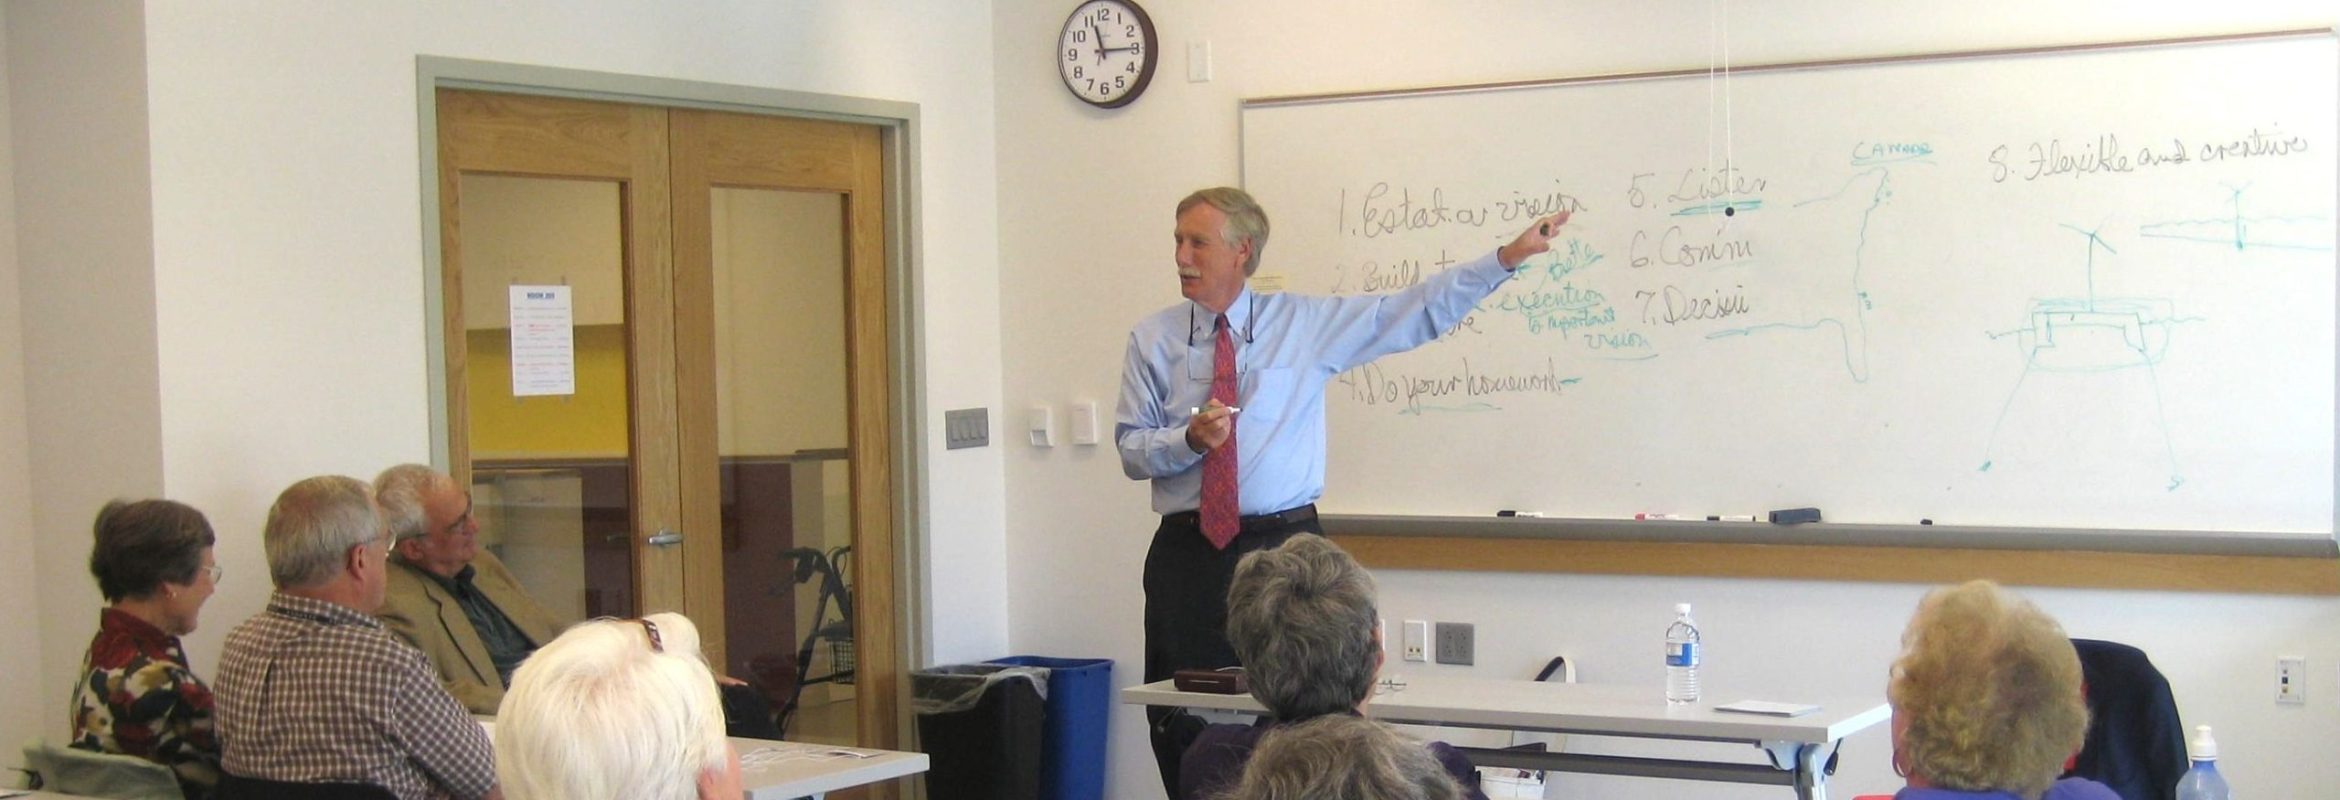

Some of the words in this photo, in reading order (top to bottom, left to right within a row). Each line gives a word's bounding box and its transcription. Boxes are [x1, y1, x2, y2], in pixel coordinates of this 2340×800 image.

[1097, 8, 1110, 21] 12
[1084, 15, 1094, 28] 11
[1073, 31, 1086, 43] 10
[1126, 24, 1135, 38] 2
[1068, 49, 1078, 61] 9
[1130, 42, 1140, 55] 3
[1074, 66, 1083, 79] 8
[1126, 62, 1135, 74] 4
[1086, 78, 1095, 91] 7
[1100, 82, 1110, 96] 6
[1115, 76, 1125, 89] 5
[2136, 138, 2191, 167] and
[2200, 121, 2309, 162] creative
[1667, 159, 1767, 203] Listen
[1361, 261, 1421, 293] Build
